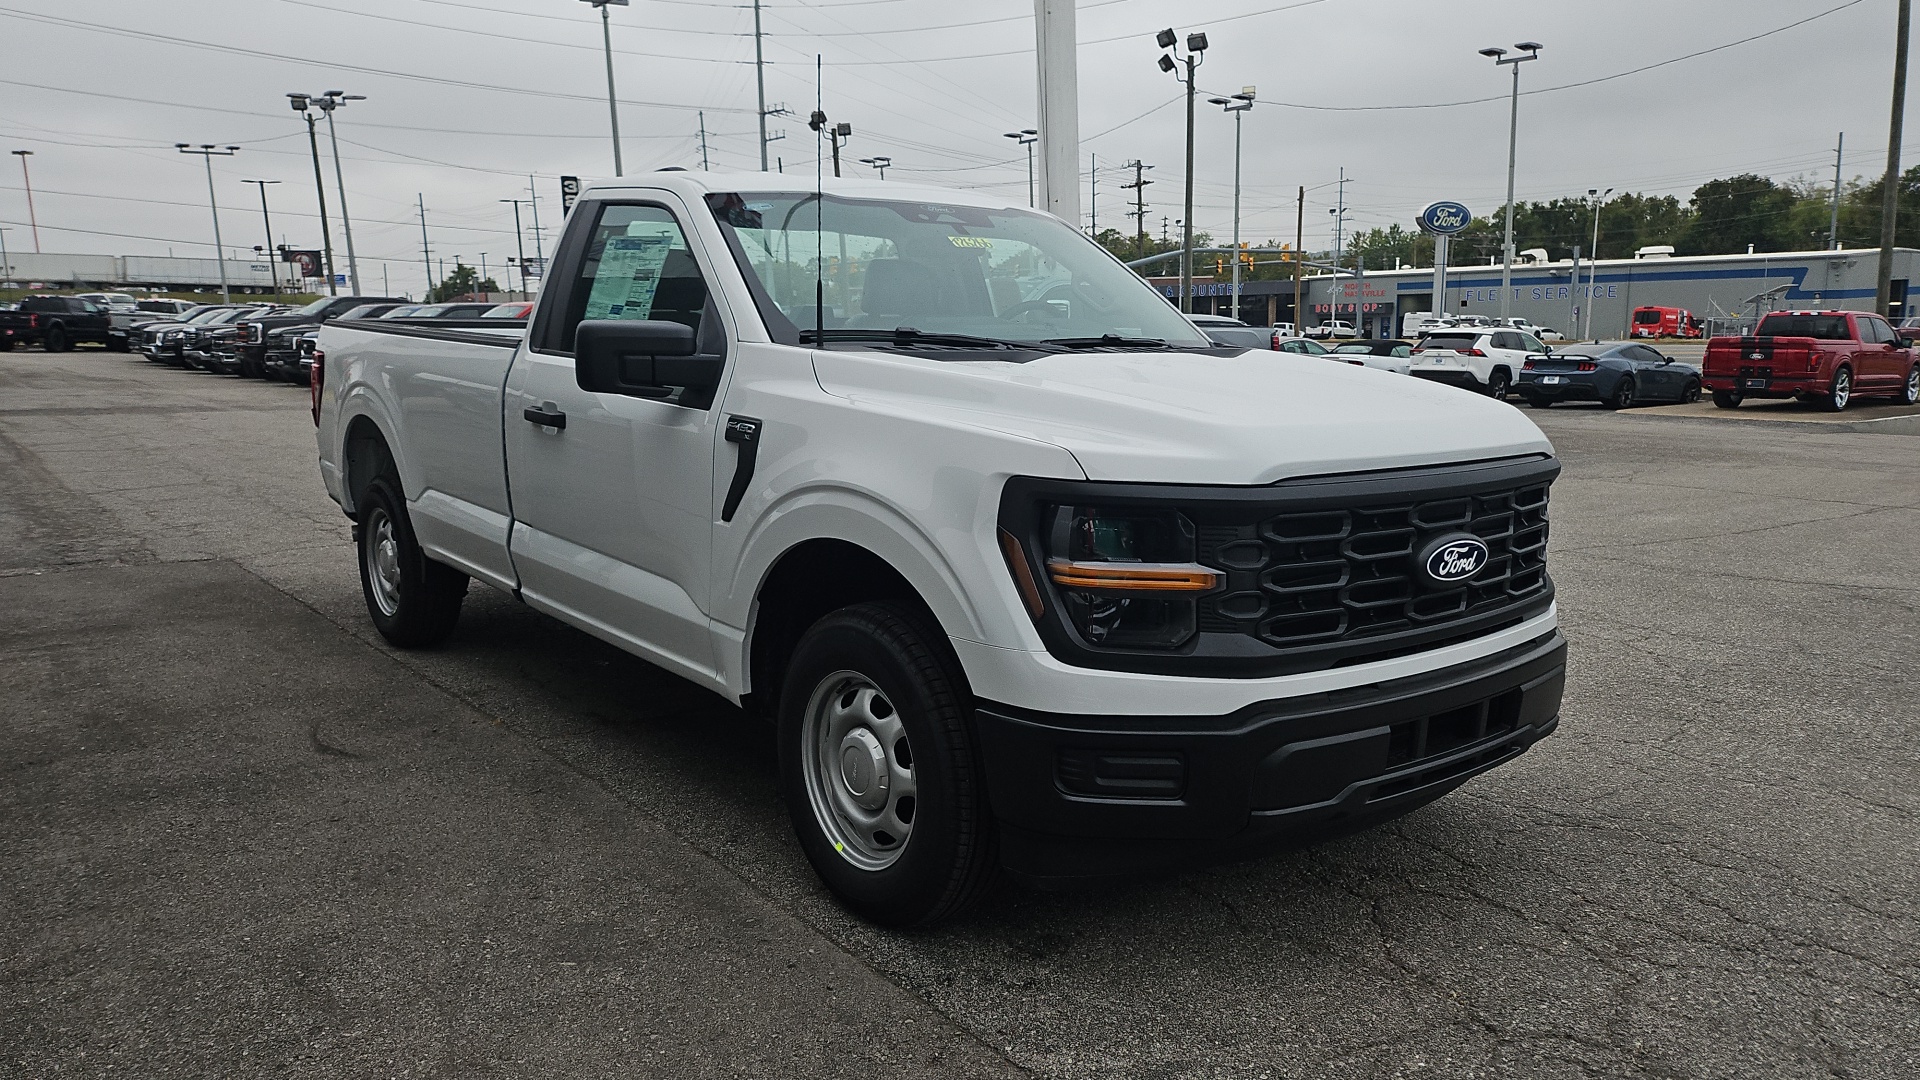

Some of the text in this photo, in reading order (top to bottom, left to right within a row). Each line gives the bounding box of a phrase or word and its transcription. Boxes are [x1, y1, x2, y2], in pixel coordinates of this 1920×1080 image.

[1433, 207, 1463, 227] Ford
[1344, 282, 1371, 290] NOTH
[1465, 288, 1521, 302] FLET
[1347, 303, 1378, 313] SOP
[1439, 546, 1478, 576] Ford
